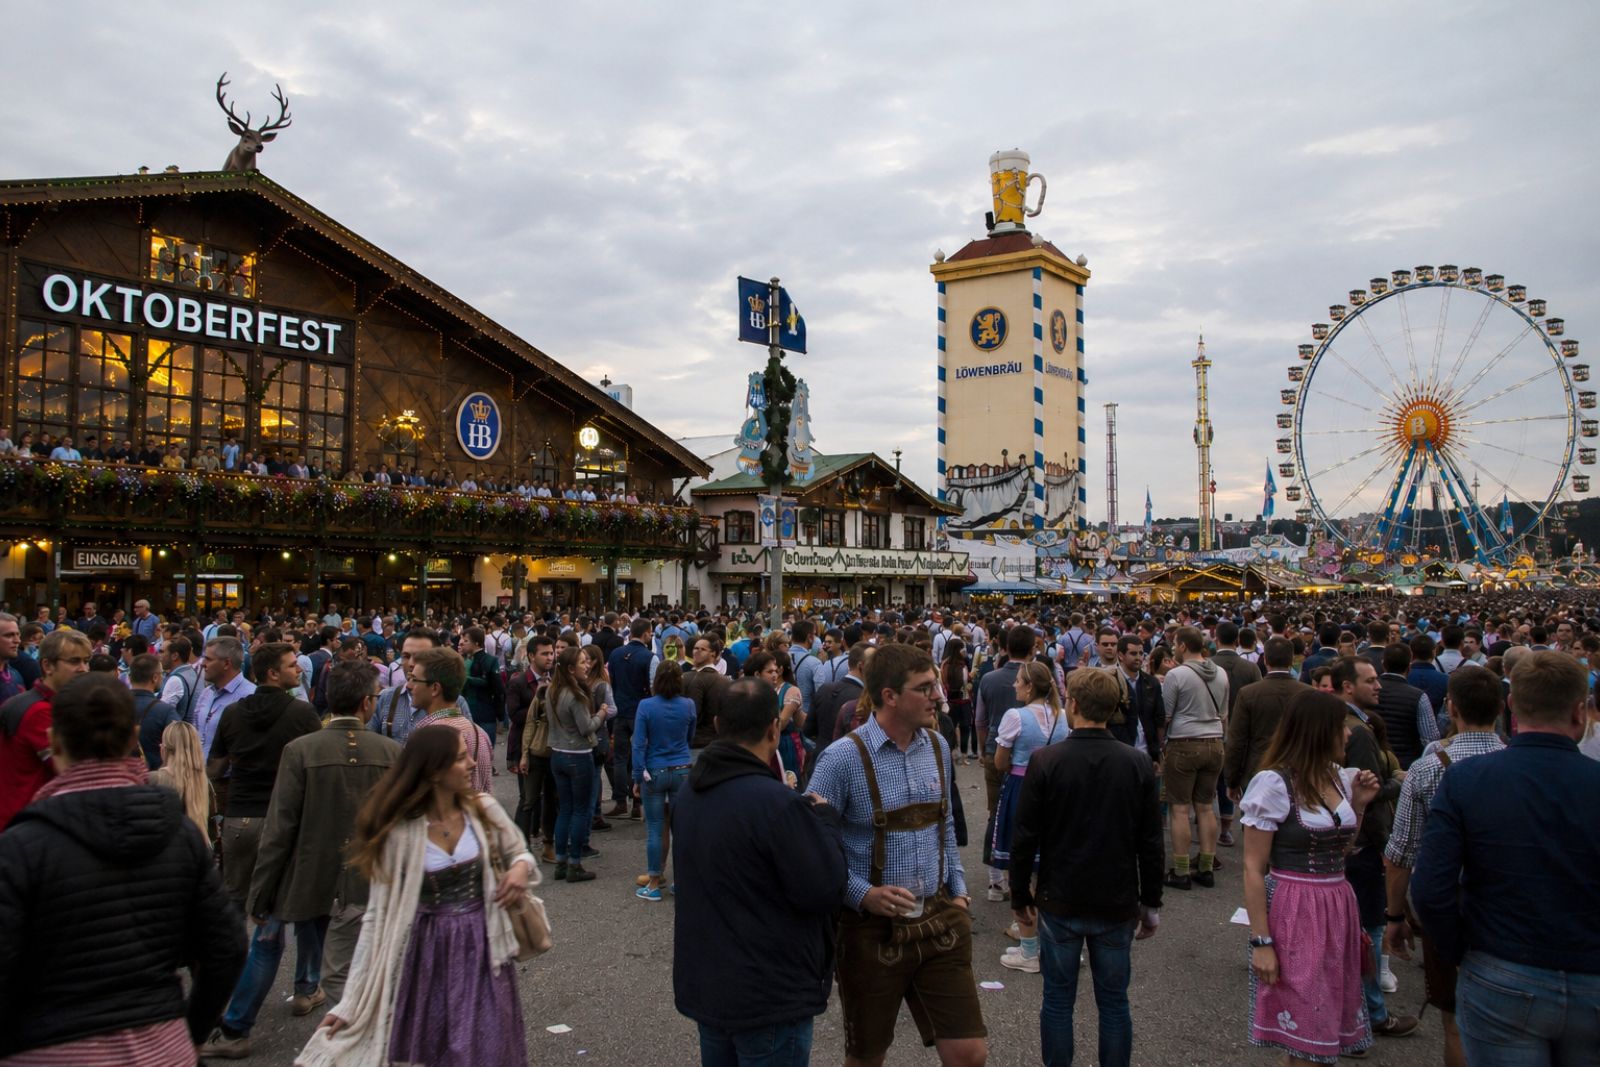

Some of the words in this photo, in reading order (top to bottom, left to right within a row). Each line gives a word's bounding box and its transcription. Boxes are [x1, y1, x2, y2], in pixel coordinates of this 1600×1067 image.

[42, 274, 341, 354] OKTOBERFEST
[750, 312, 766, 329] HB
[955, 361, 1022, 379] LÖWENBRÄU
[467, 423, 492, 449] HB
[77, 552, 137, 566] EINGANG
